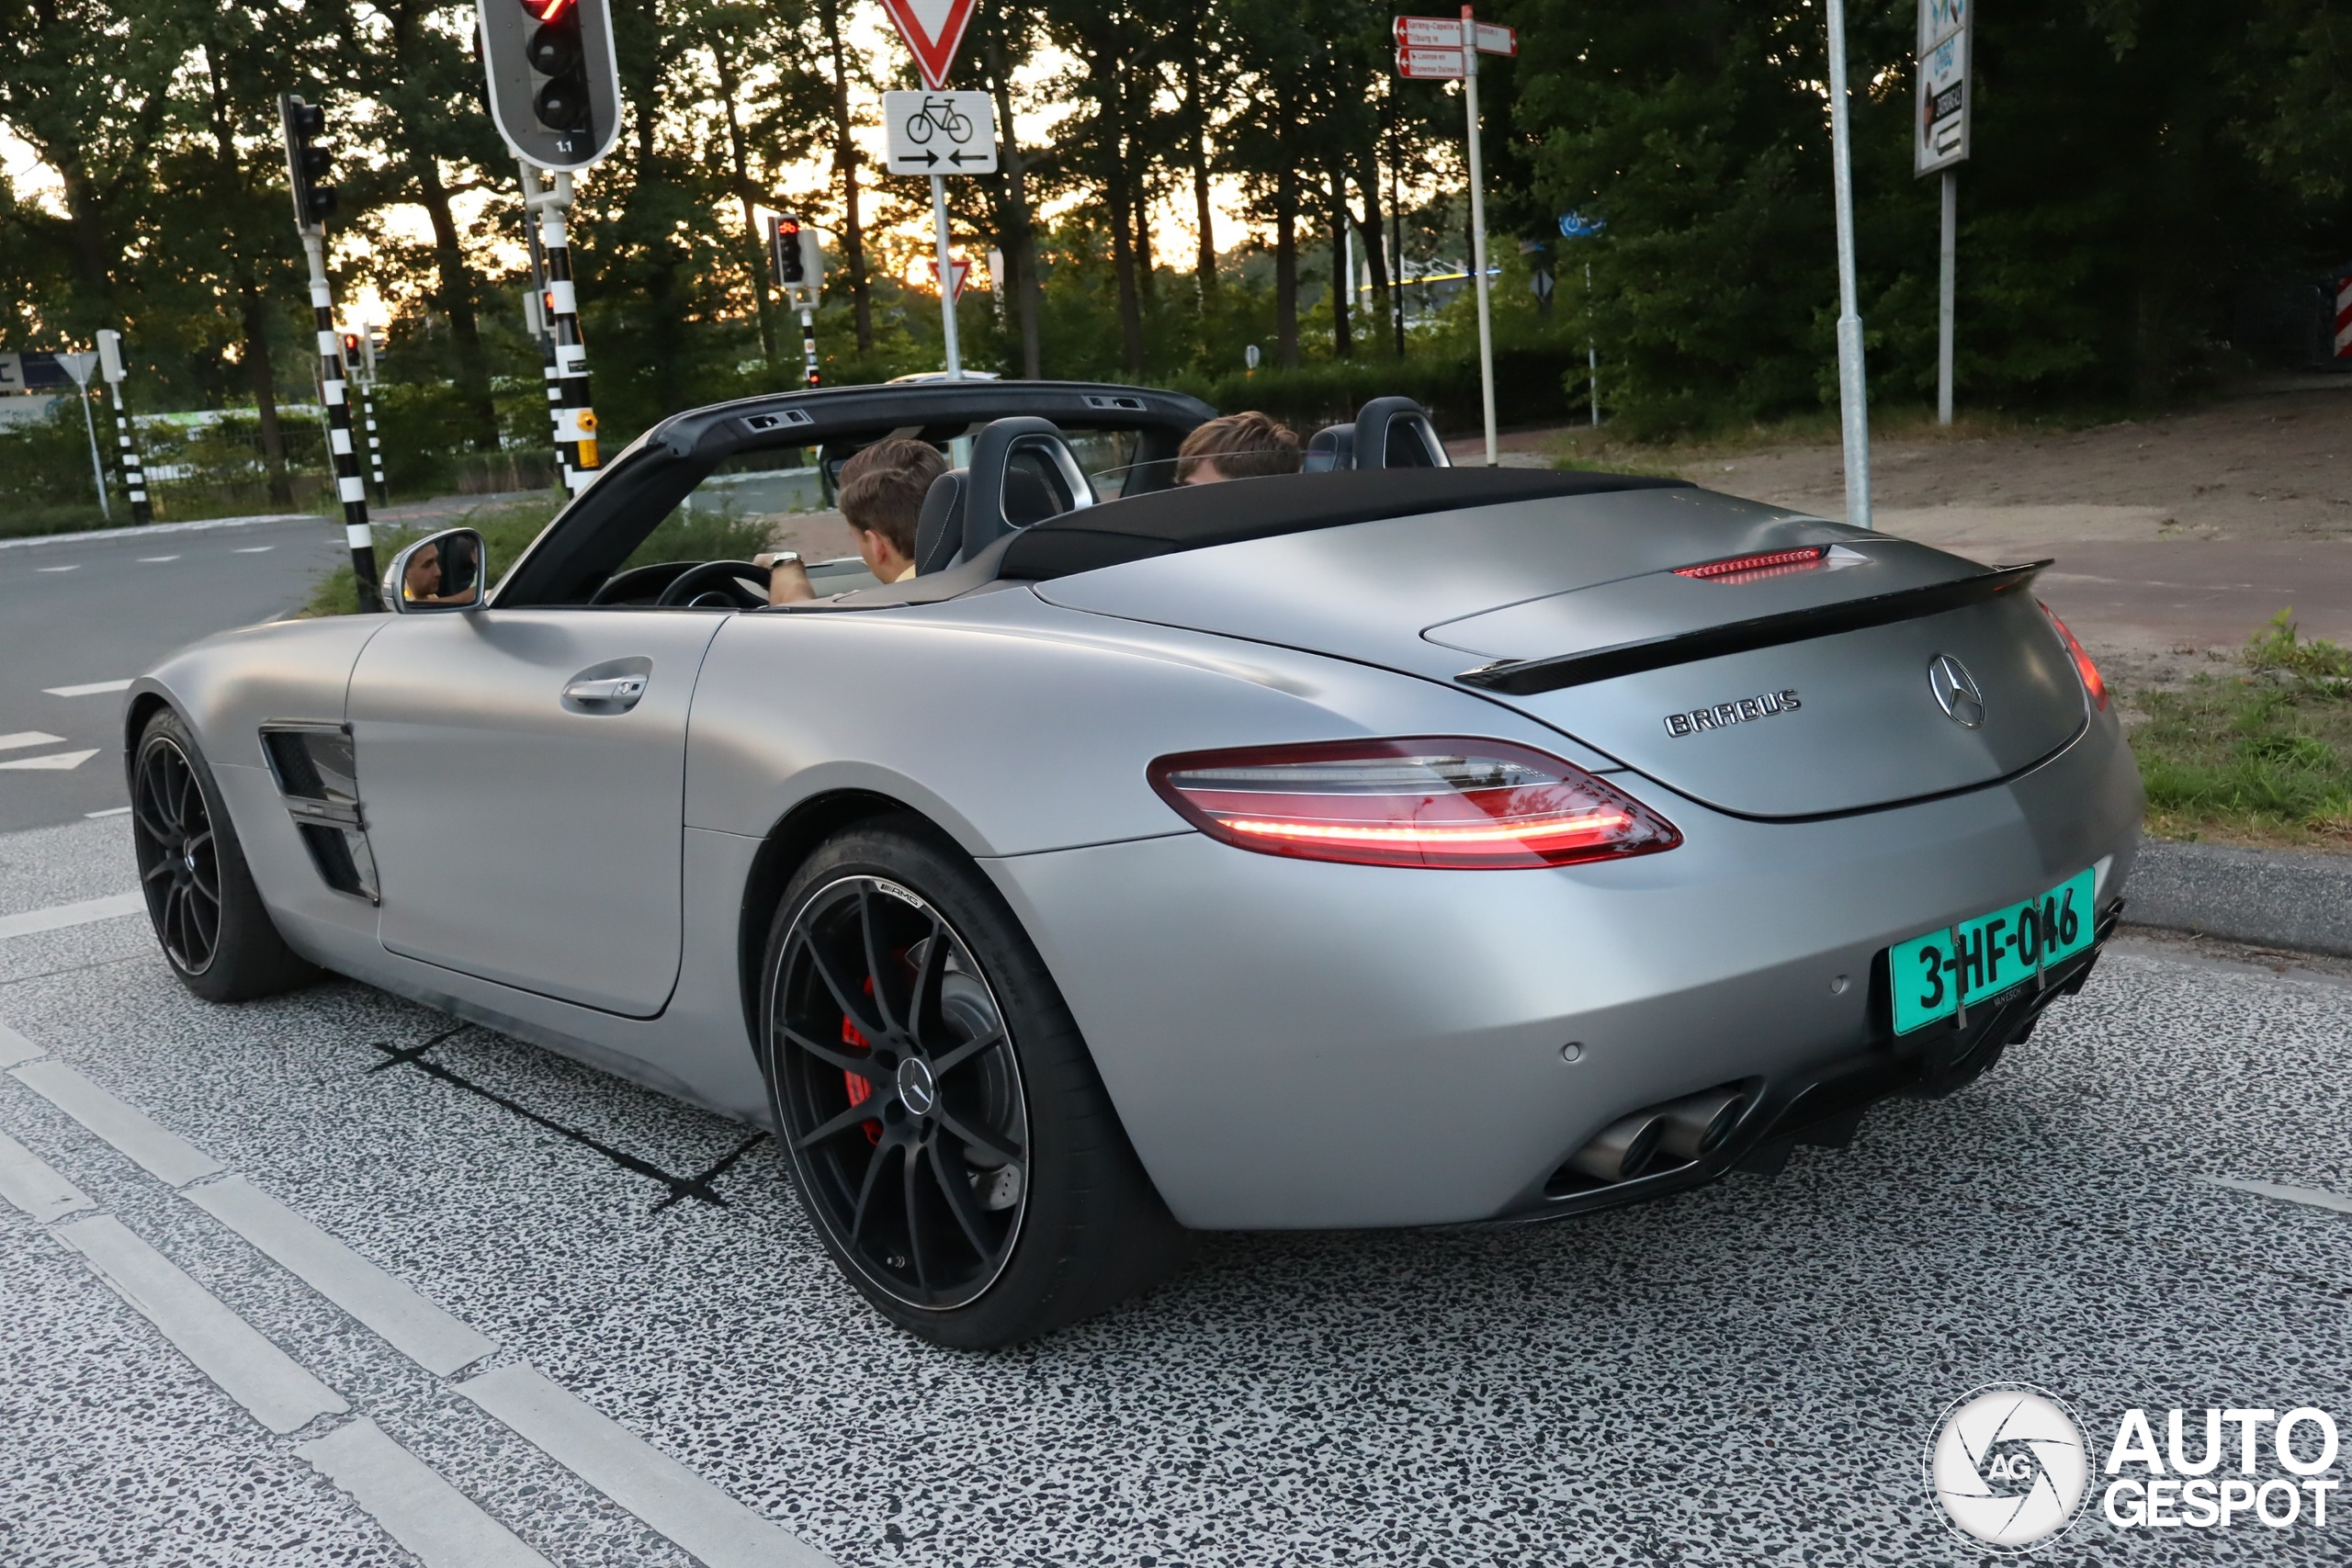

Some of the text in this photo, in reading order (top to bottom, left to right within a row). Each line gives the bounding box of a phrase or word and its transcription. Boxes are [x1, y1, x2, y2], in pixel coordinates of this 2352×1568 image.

[1408, 33, 1431, 44] Tilburg
[1664, 689, 1802, 738] BRABUS
[891, 886, 918, 907] AMG
[1919, 887, 2078, 1009] 3-HF-046
